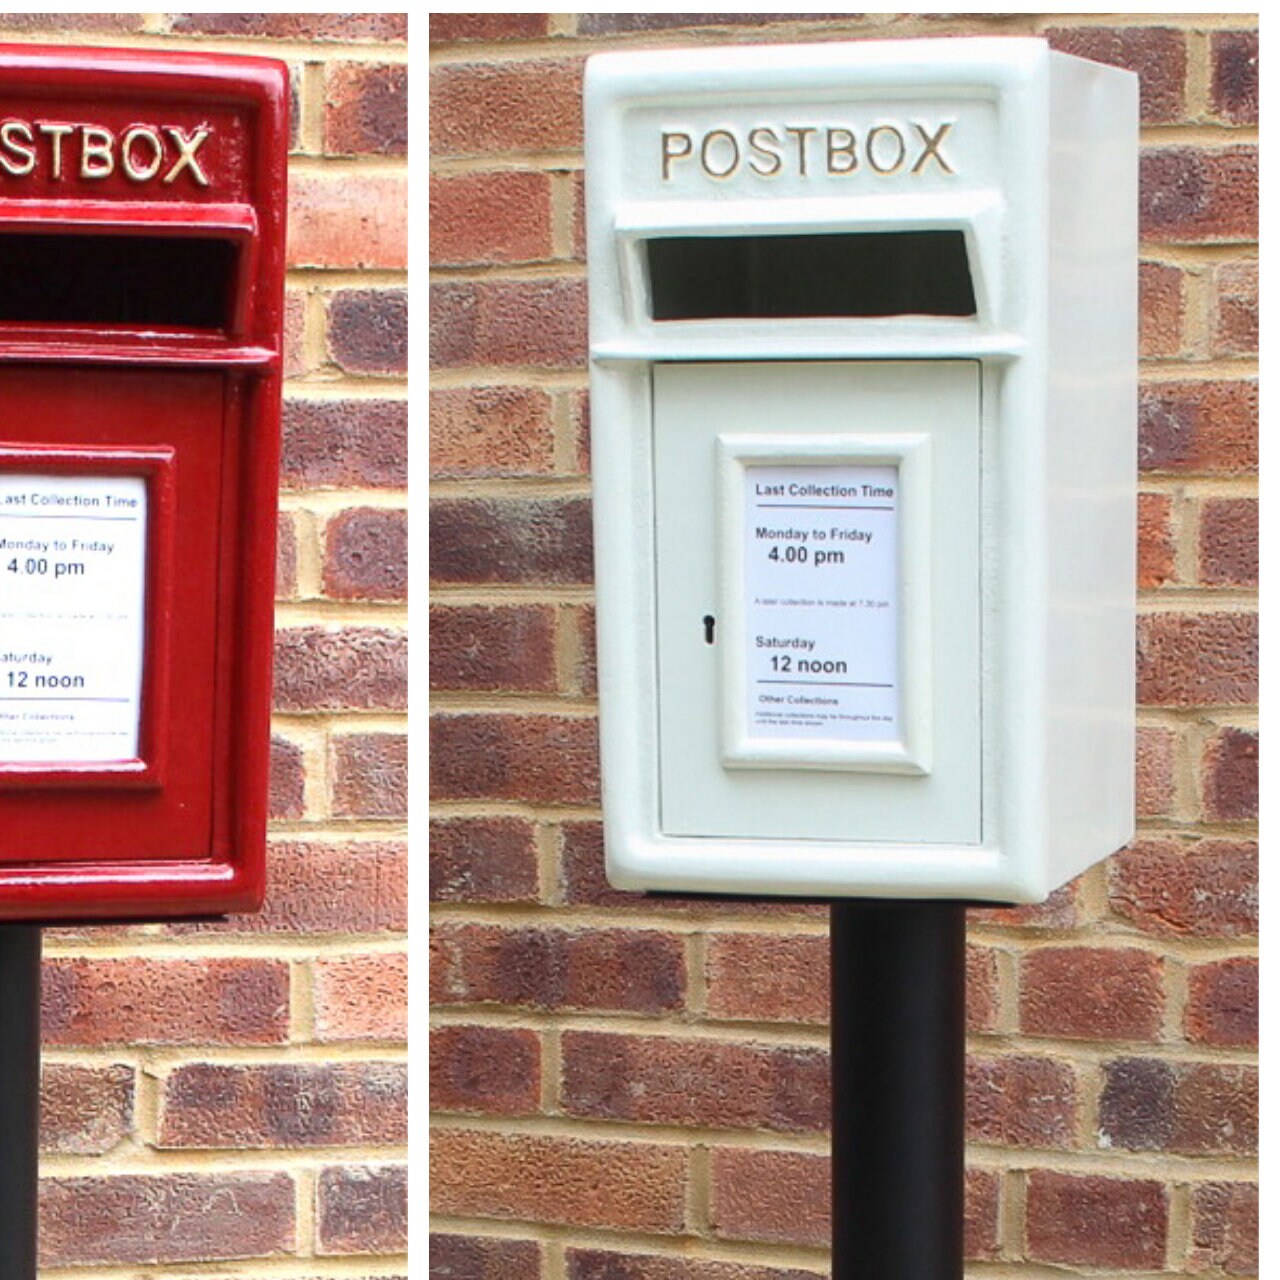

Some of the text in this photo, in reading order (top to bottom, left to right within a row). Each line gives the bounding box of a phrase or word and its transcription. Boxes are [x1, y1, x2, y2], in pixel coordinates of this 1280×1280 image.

[661, 122, 955, 180] POSTBOX
[756, 483, 894, 498] Last Collection Time
[31, 493, 99, 506] Collection
[105, 495, 138, 508] Time
[756, 527, 872, 544] Monday to Friday
[53, 540, 67, 551] to
[72, 539, 114, 555] Friday
[768, 546, 846, 567] 4.00 pm
[7, 558, 85, 579] 4.00 pm
[756, 635, 816, 652] Saturday
[771, 655, 848, 673] 12 noon
[7, 671, 85, 688] 12 noon
[758, 695, 839, 706] Other Collections
